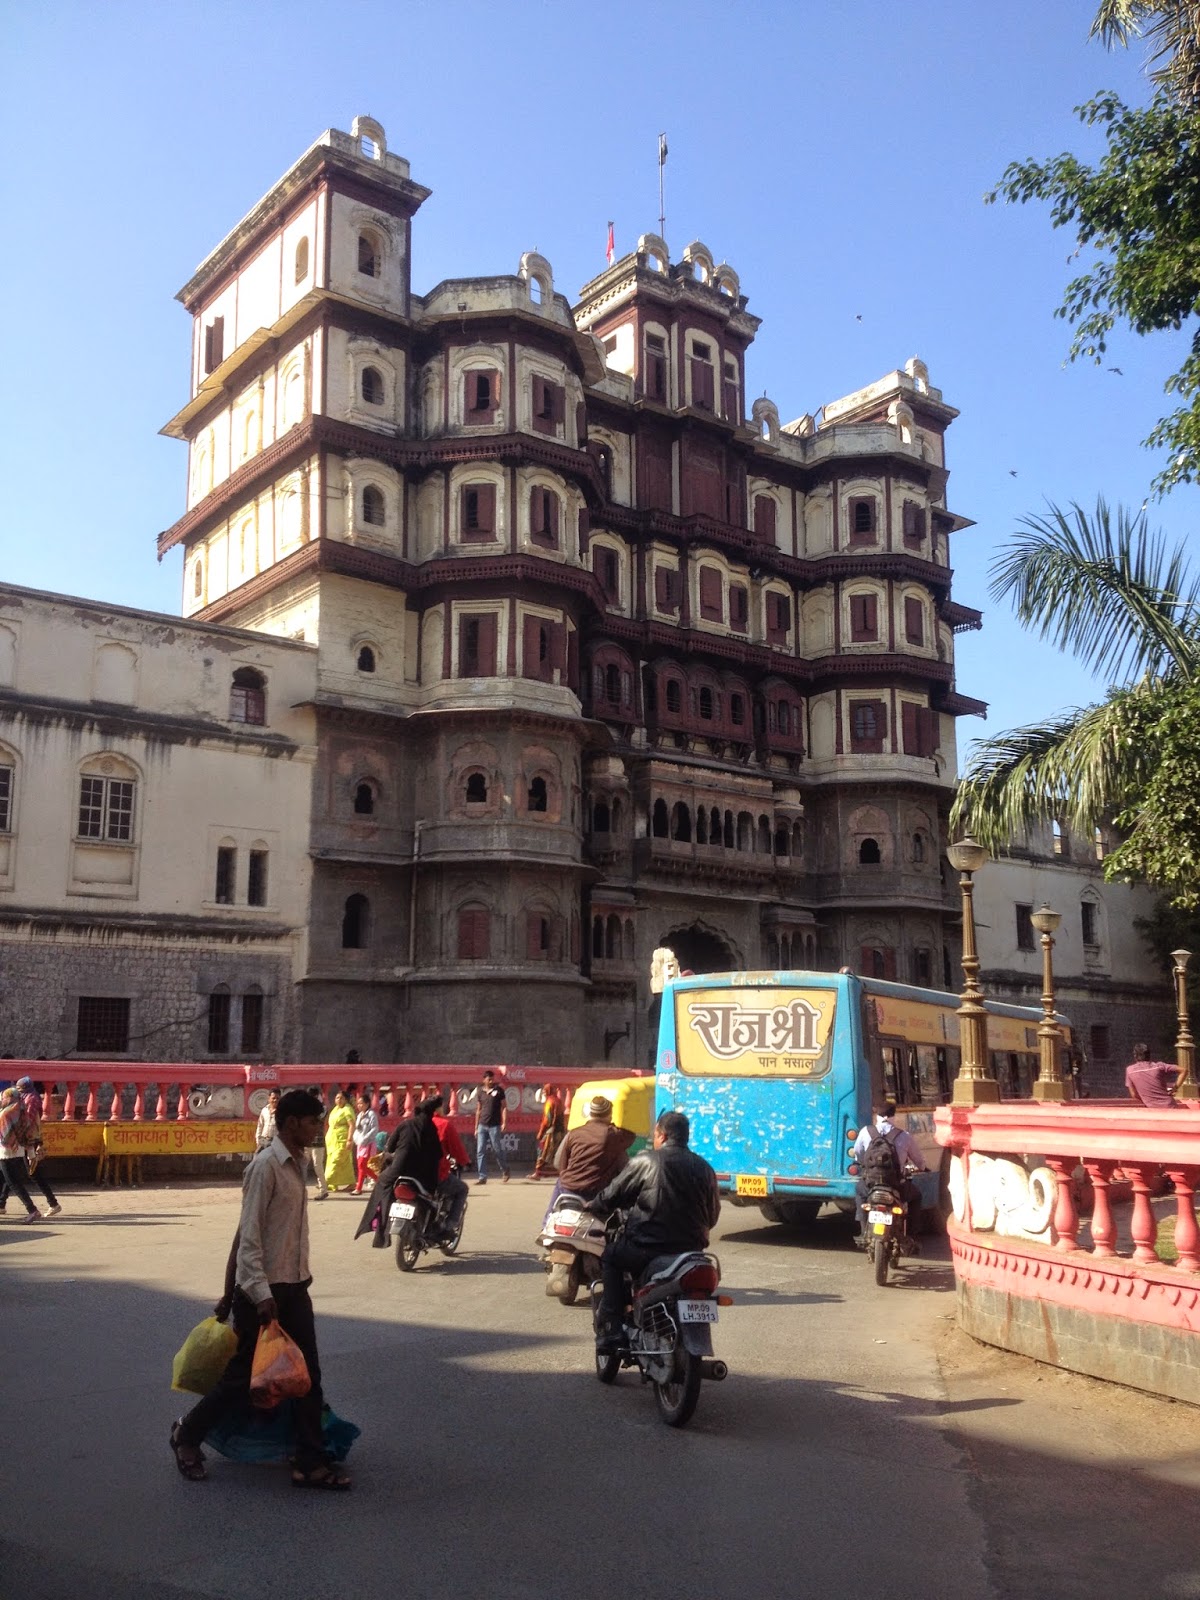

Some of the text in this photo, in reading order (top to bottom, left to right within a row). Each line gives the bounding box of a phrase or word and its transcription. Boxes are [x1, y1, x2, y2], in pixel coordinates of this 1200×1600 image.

[691, 1002, 818, 1056] राजश्री
[758, 1057, 817, 1070] पान मसाल
[113, 1129, 169, 1145] यातायात
[172, 1126, 209, 1148] पुलिस
